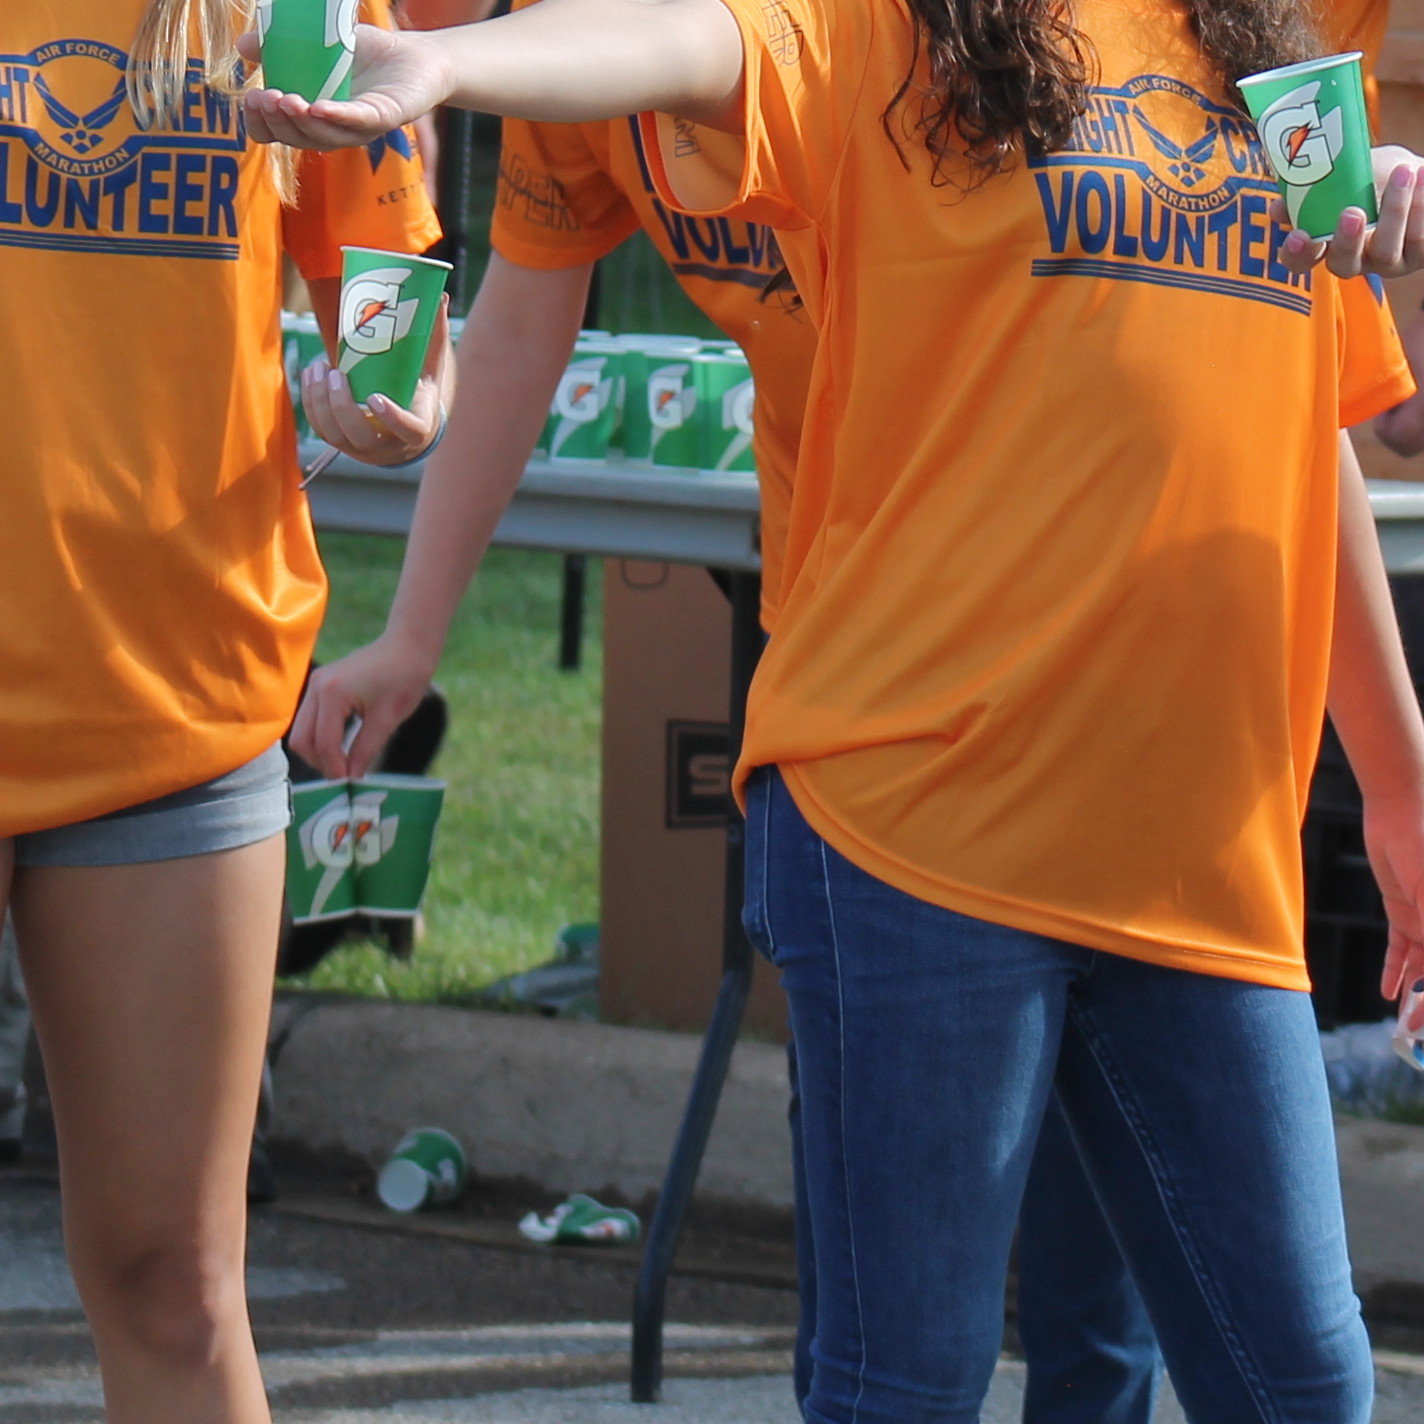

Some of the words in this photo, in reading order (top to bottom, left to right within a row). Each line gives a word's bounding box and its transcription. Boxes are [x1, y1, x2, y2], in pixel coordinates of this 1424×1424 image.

[35, 44, 62, 64] AIR
[64, 41, 121, 65] FORCE
[1128, 78, 1152, 97] AIR
[1152, 77, 1203, 105] FORCE
[34, 142, 130, 176] MARATHON
[1263, 99, 1334, 187] G
[1145, 174, 1232, 213] MARATHON
[343, 279, 402, 356] G
